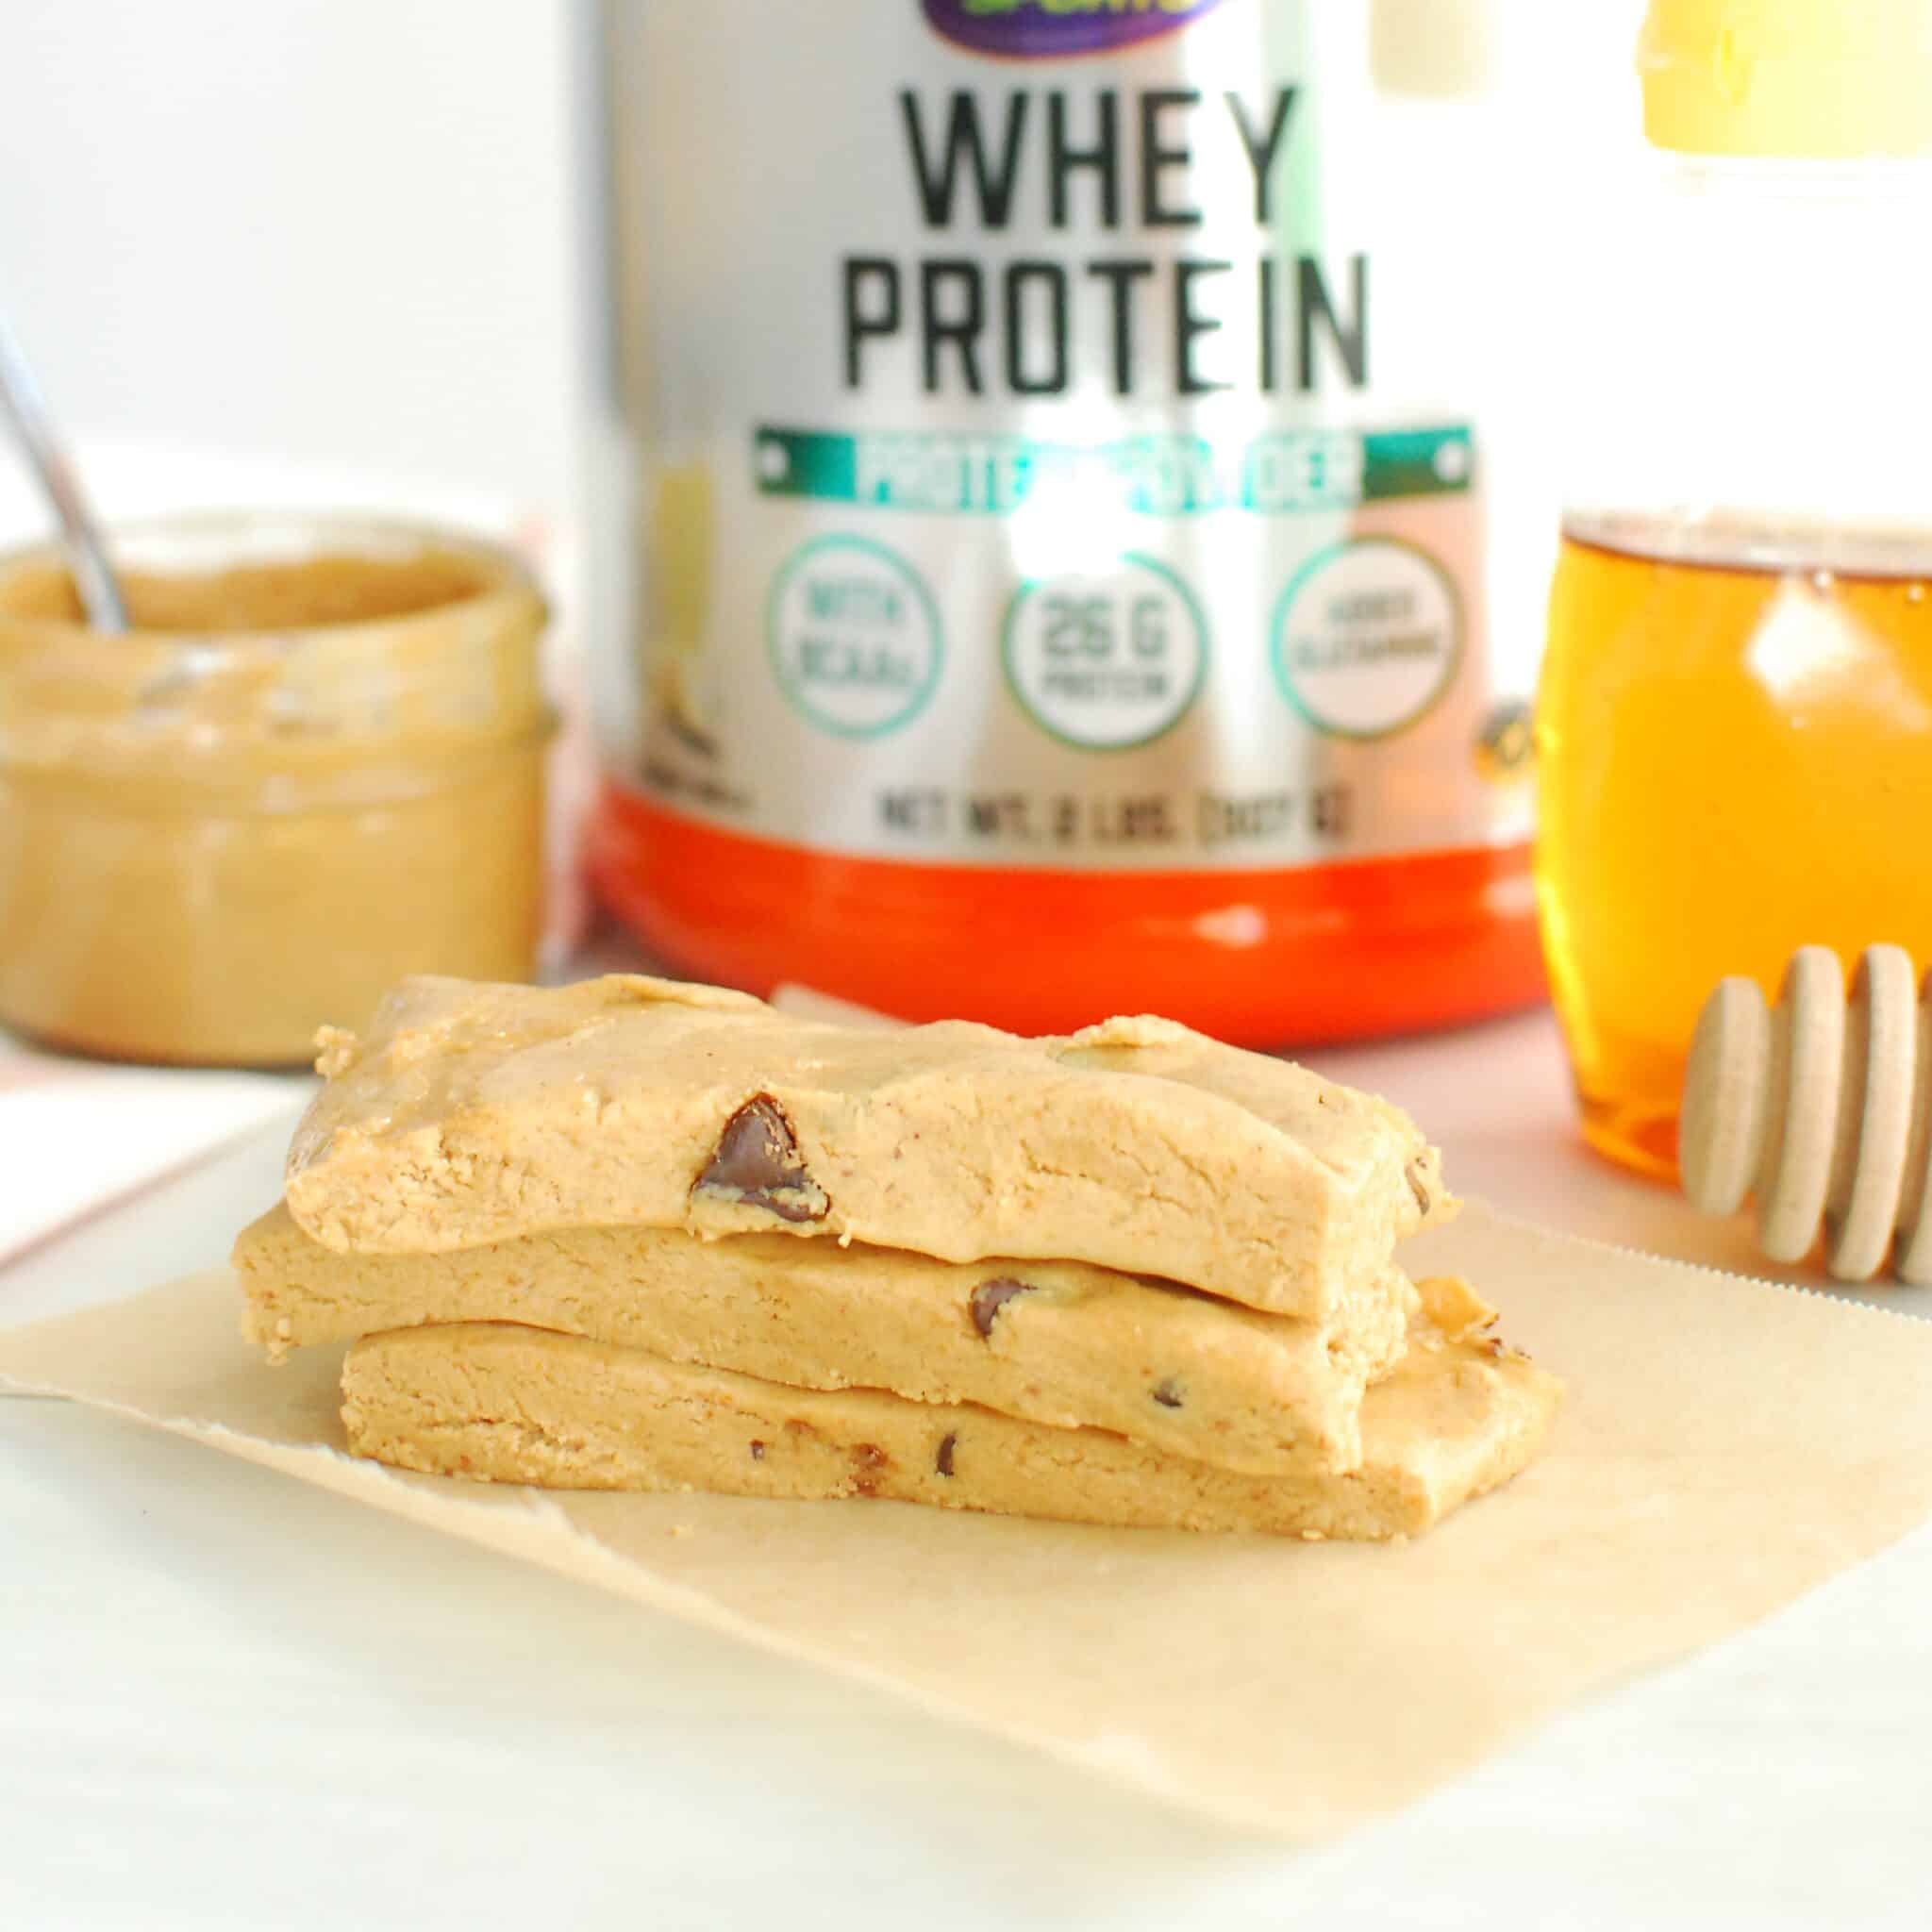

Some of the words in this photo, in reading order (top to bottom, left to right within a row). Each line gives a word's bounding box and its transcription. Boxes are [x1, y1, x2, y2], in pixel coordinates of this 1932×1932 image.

[898, 88, 1299, 230] WHEY
[841, 252, 1371, 397] PROTEIN
[1041, 593, 1115, 659] 26
[1131, 593, 1169, 658] G
[1041, 670, 1170, 703] PROTEIN
